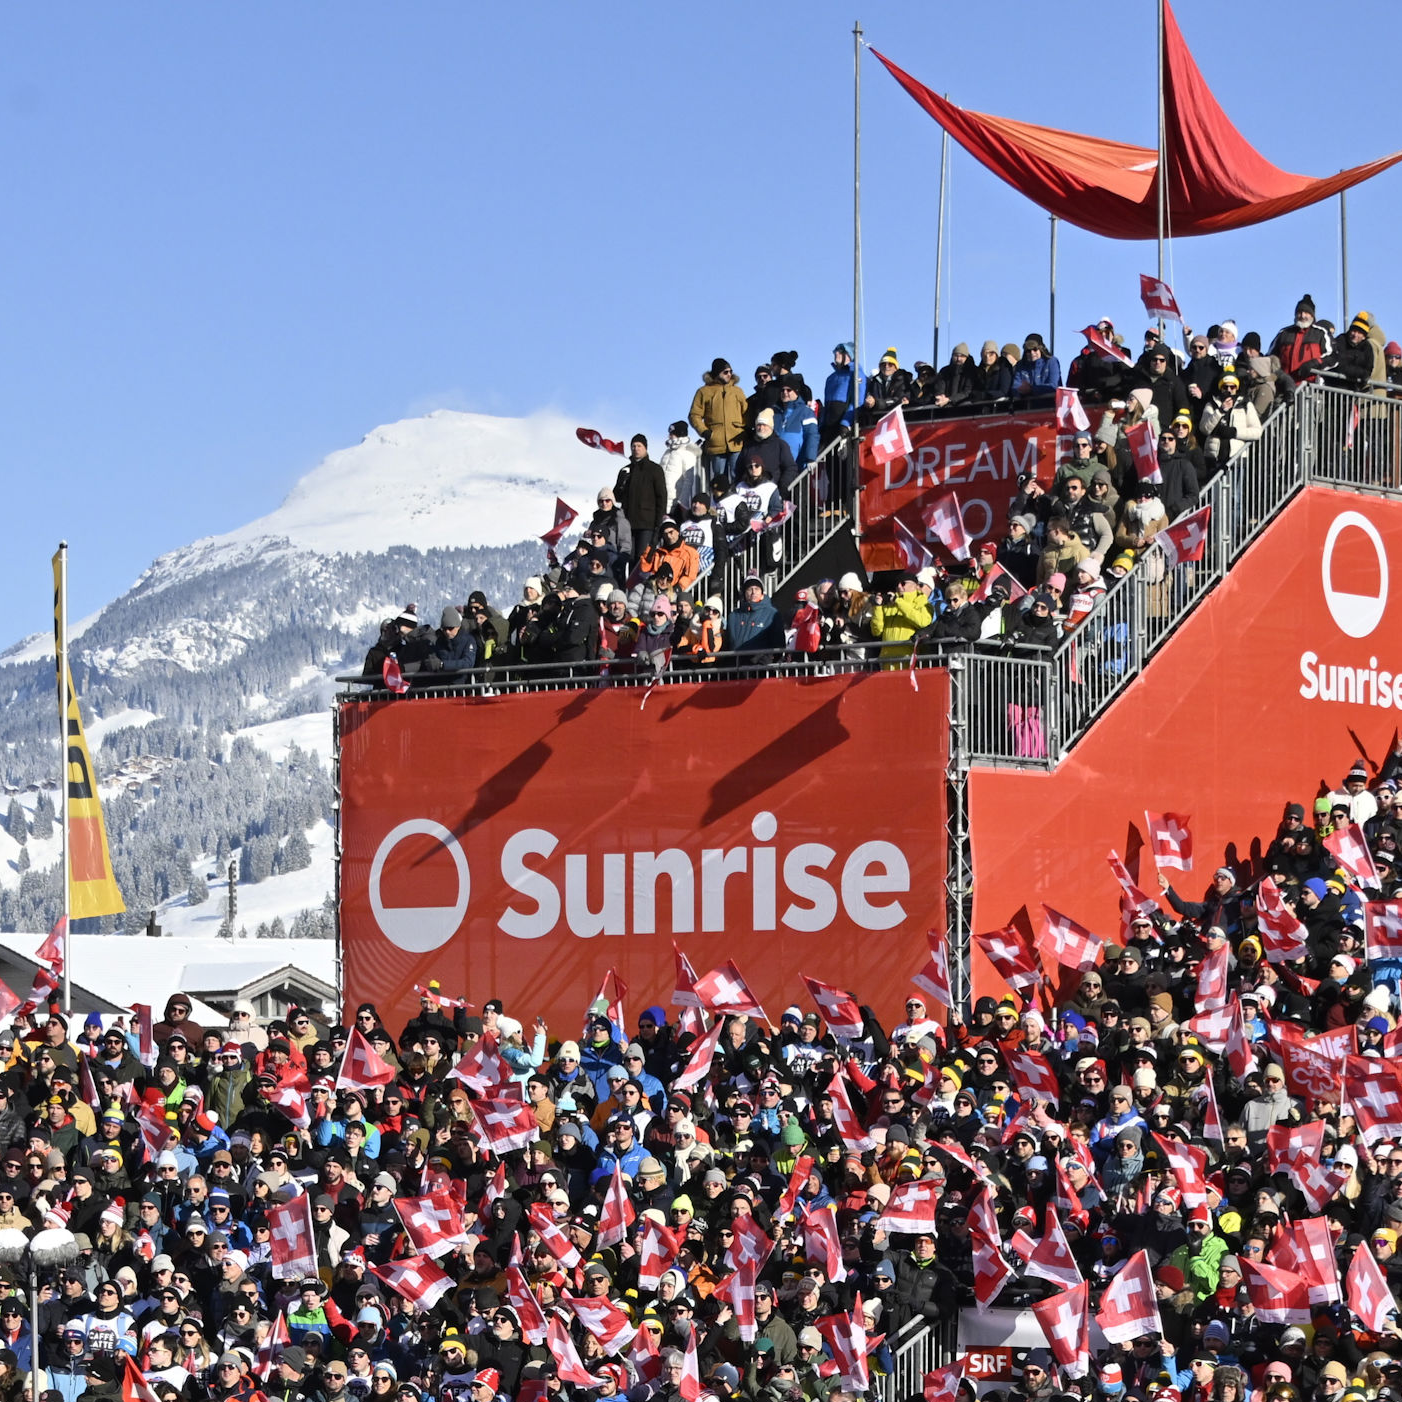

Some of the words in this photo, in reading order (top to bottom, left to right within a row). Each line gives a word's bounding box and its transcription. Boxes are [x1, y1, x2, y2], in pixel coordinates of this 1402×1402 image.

[884, 438, 1038, 489] DREAM
[497, 811, 910, 938] Sunrise
[969, 1354, 1007, 1373] SRF
